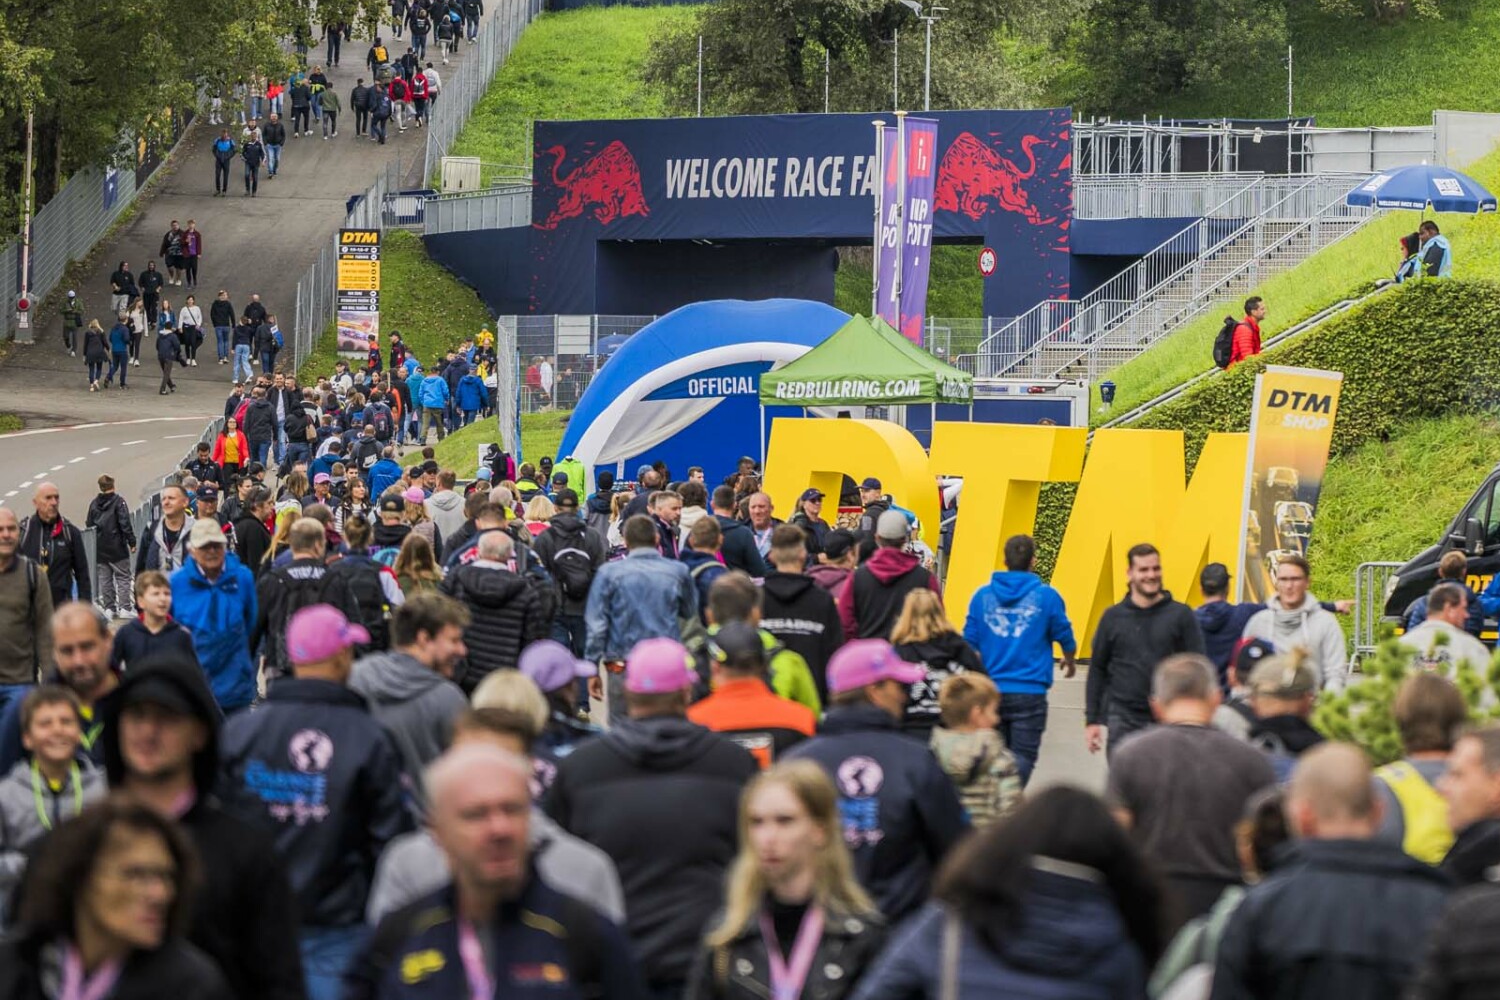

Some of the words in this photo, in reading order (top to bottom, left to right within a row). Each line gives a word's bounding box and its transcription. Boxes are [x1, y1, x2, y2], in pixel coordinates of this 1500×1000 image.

[666, 157, 778, 199] WELCOME
[783, 156, 844, 197] RACE
[850, 155, 877, 196] FA
[341, 232, 378, 244] DTM
[688, 377, 757, 396] OFFICIAL
[775, 380, 921, 398] REDBULLRING.COM
[1267, 388, 1332, 414] DTM
[1282, 413, 1329, 431] SHOP
[762, 417, 1250, 659] DTM
[1465, 574, 1494, 595] DT
